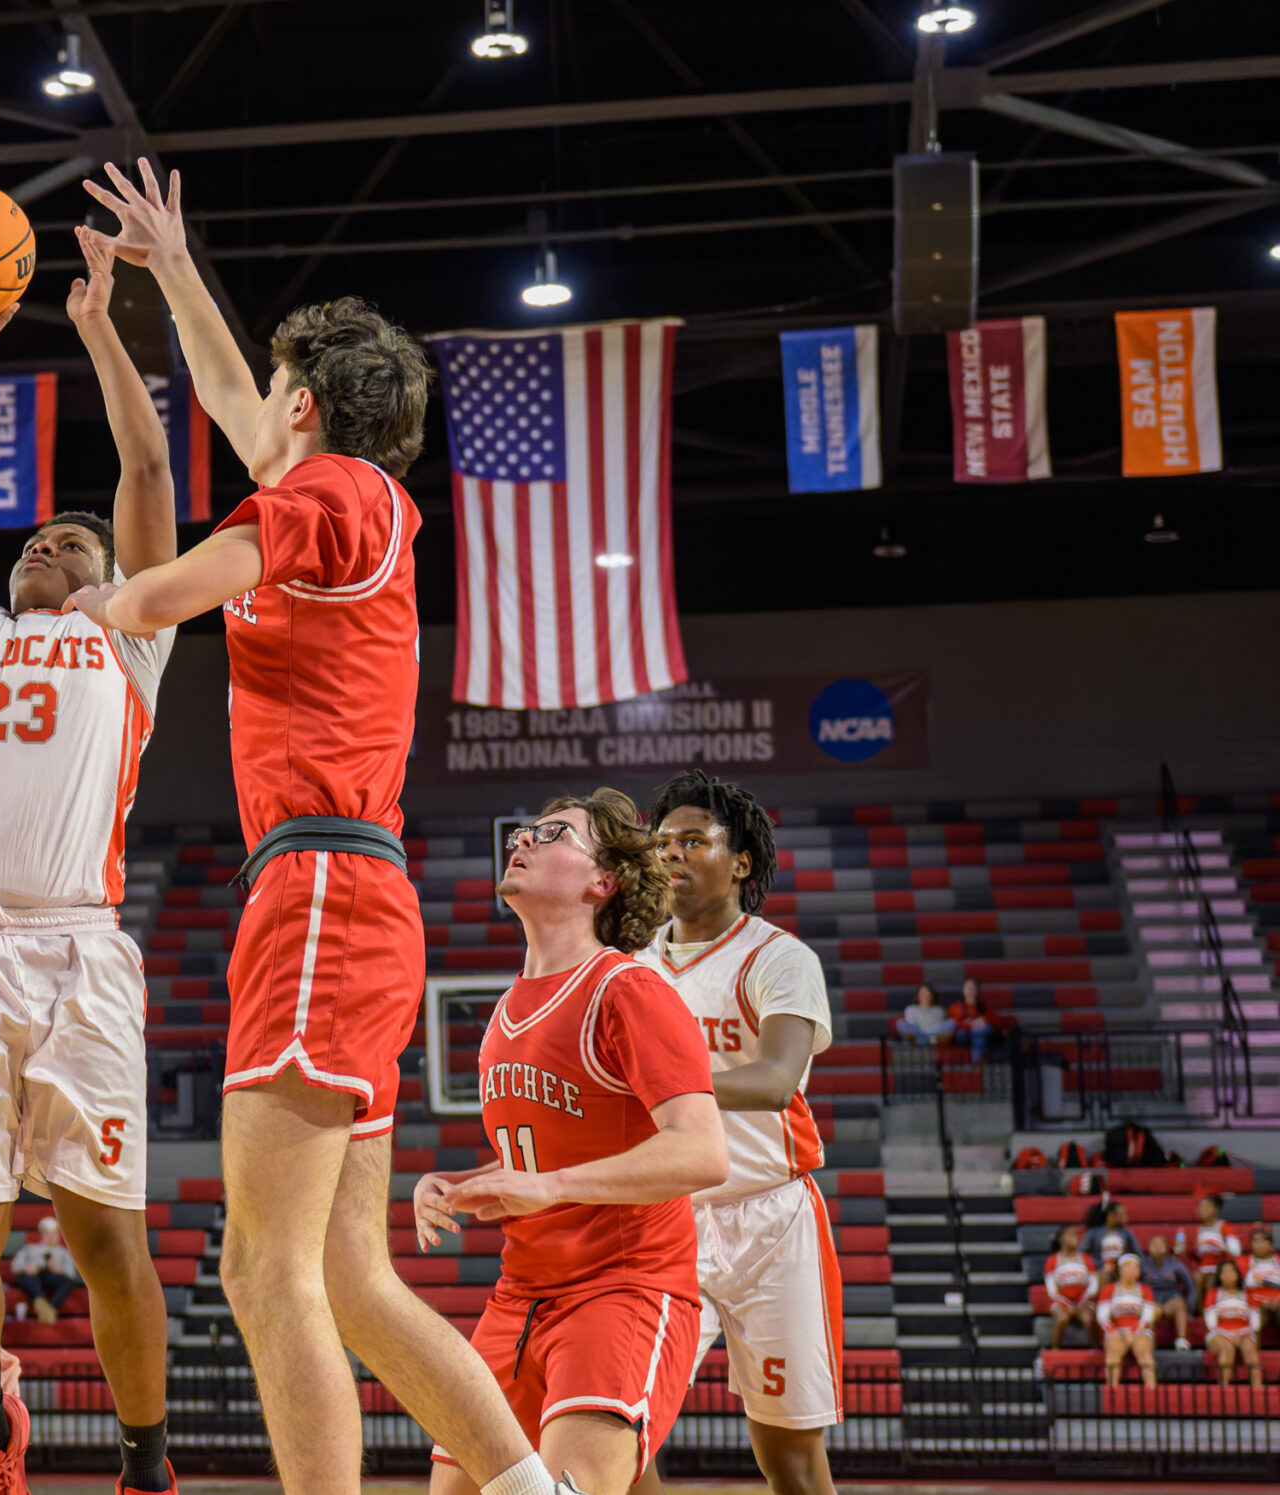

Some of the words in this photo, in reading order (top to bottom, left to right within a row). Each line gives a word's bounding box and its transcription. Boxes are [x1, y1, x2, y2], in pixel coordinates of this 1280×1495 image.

[960, 328, 985, 418] MEXICO
[1130, 357, 1156, 428] SAM
[1156, 319, 1190, 467] HOUSTON
[821, 344, 849, 476] TENNESSEE
[989, 364, 1014, 439] STATE
[962, 425, 987, 477] NEW
[446, 712, 519, 739] 1985
[528, 706, 608, 737] NCAA
[616, 700, 745, 731] DIVISION
[752, 698, 773, 729] II
[818, 717, 894, 743] NCAA
[446, 738, 591, 771] NATIONAL
[598, 732, 775, 766] CHAMPIONS
[695, 1018, 742, 1052] TS
[100, 1118, 126, 1166] S
[763, 1357, 786, 1397] S
